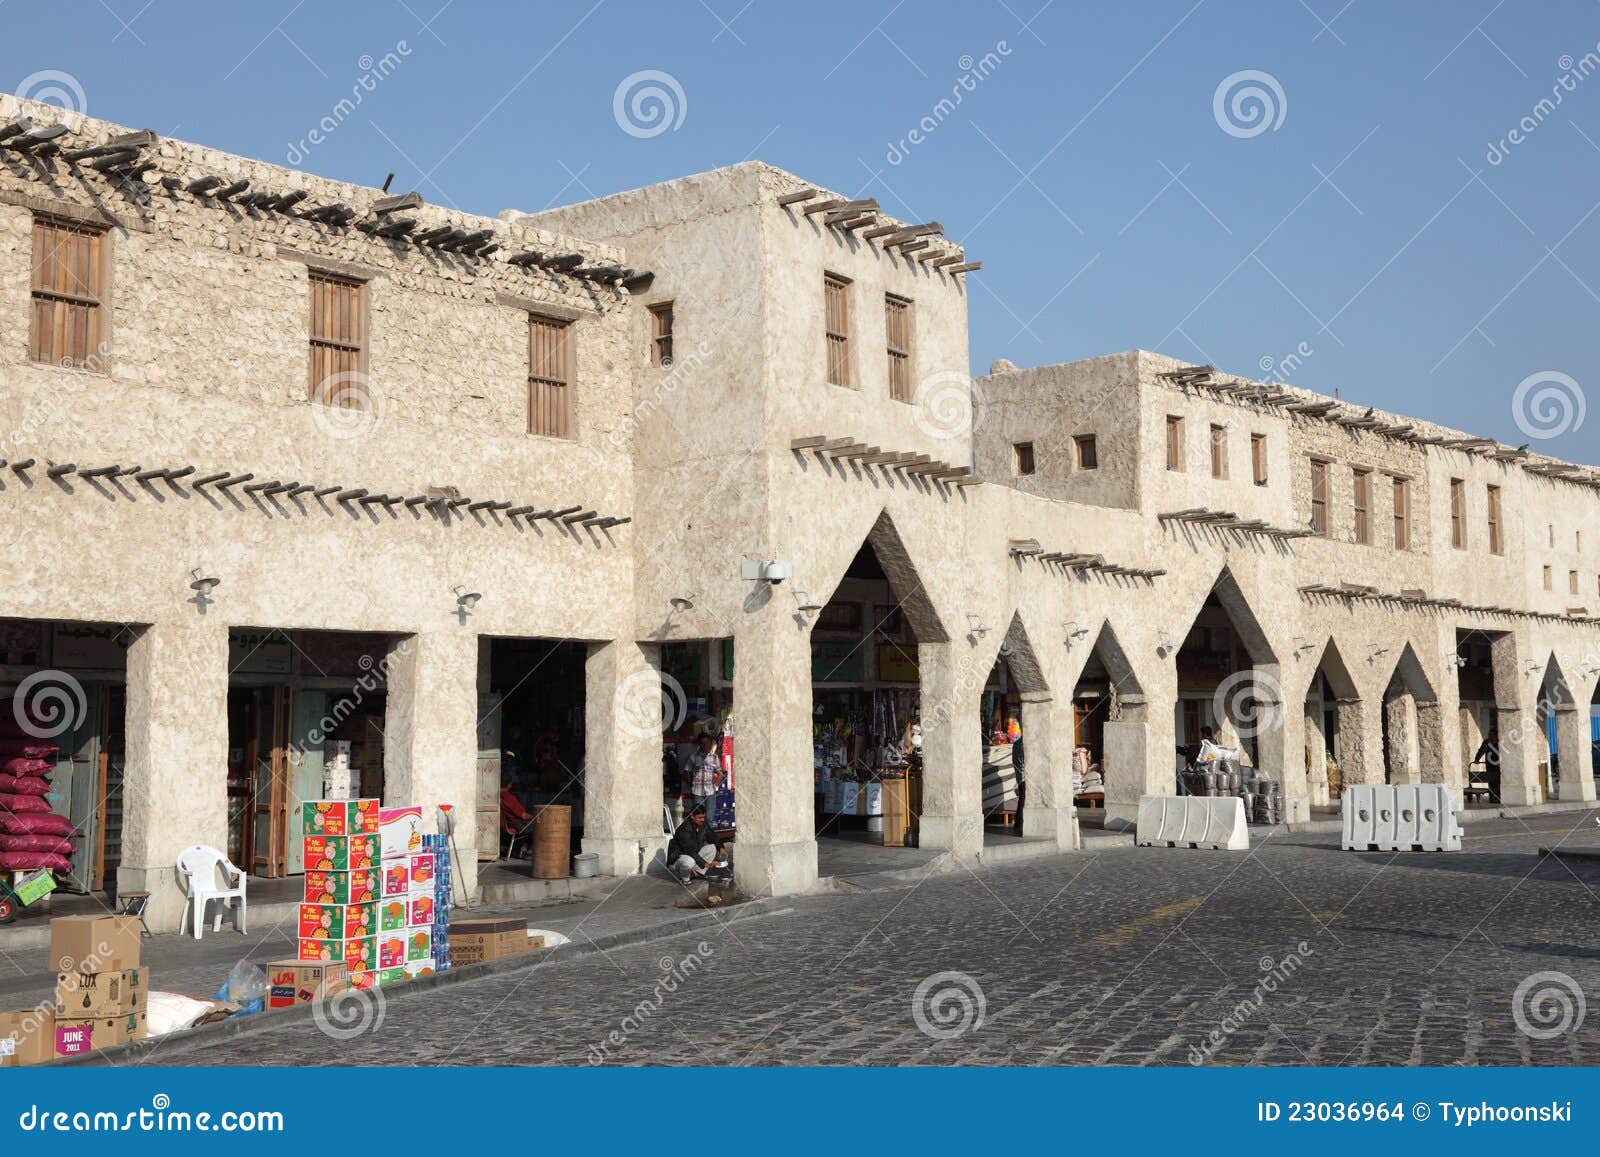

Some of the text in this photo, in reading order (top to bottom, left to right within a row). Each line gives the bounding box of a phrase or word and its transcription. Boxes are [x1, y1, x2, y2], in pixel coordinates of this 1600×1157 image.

[80, 973, 97, 988] LUX
[63, 1031, 83, 1043] JUNE
[65, 1044, 80, 1052] 2011
